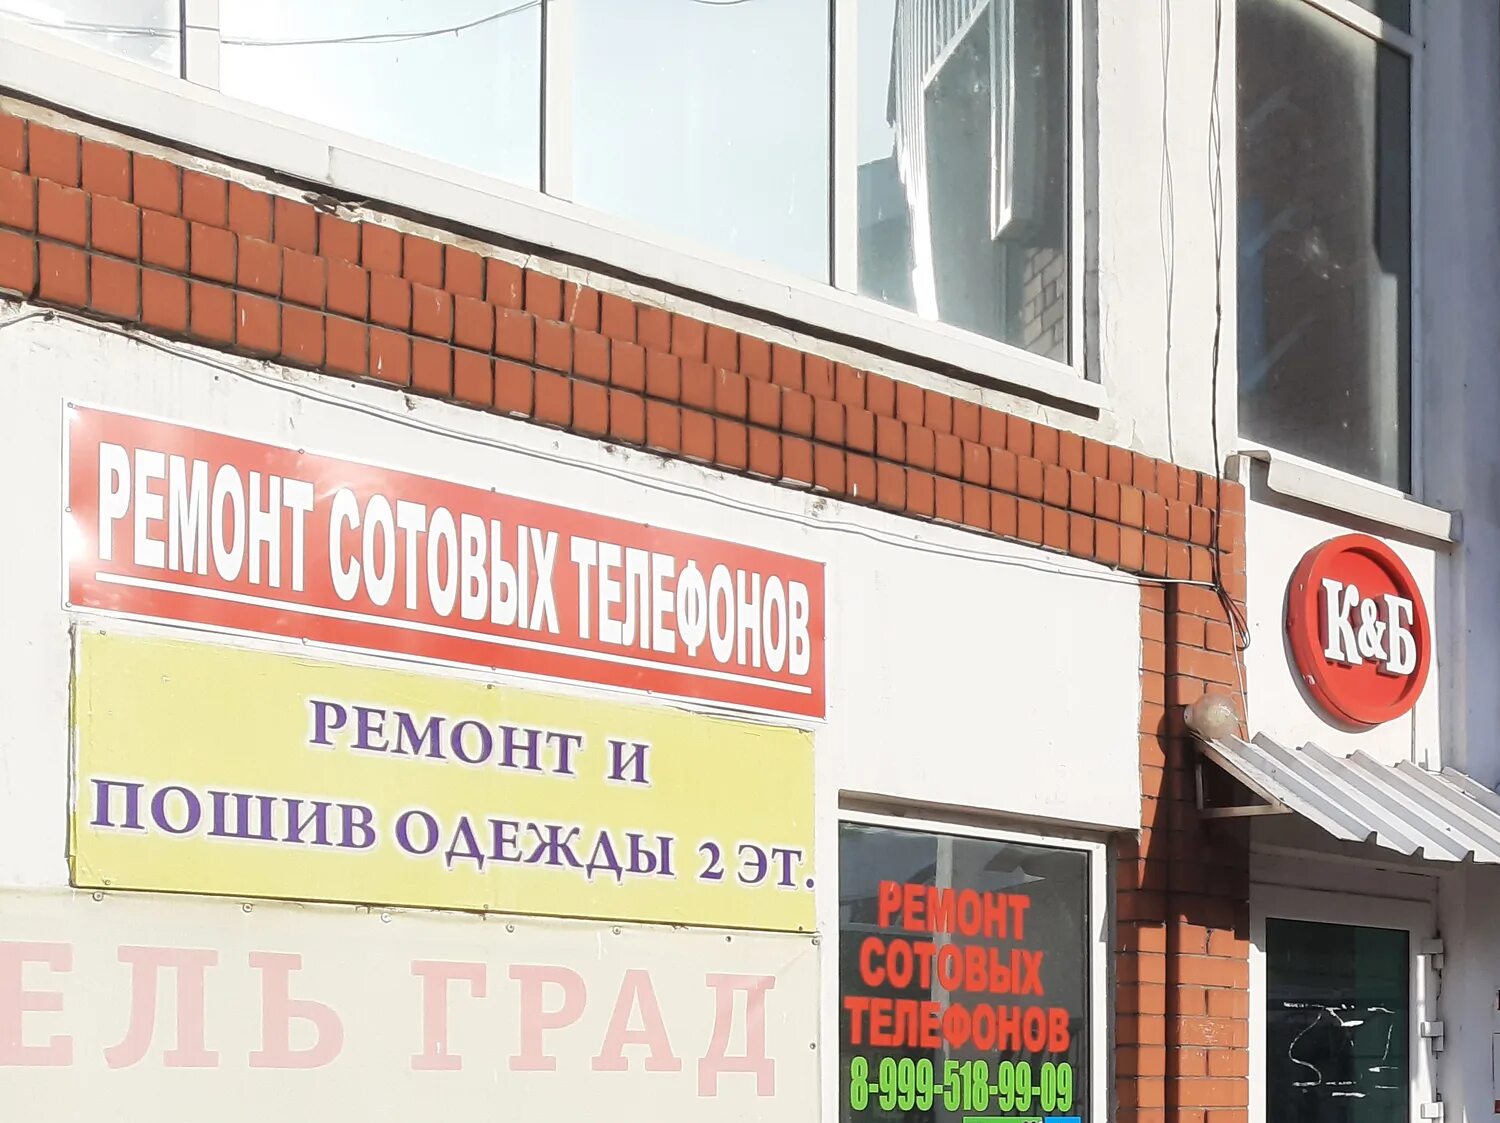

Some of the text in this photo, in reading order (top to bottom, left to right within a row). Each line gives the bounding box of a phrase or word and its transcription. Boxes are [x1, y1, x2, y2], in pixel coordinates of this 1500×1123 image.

[98, 443, 811, 676] РЕМОНТ СОТОВЫХ ТЕЛЕФОНОВ
[1321, 577, 1417, 676] К&Б
[309, 700, 650, 785] РЕМОНТ И
[89, 779, 376, 849] ПОШИВ
[394, 809, 674, 882] ОДЕЖДЫ
[878, 880, 1030, 941] РЕМОНТ
[859, 937, 1044, 996] СОТОВЫХ
[410, 959, 777, 1098] ГРАД
[844, 996, 1071, 1053] ТЕЛЕФОНОВ
[850, 1056, 1073, 1112] 8-999-518-99-09
